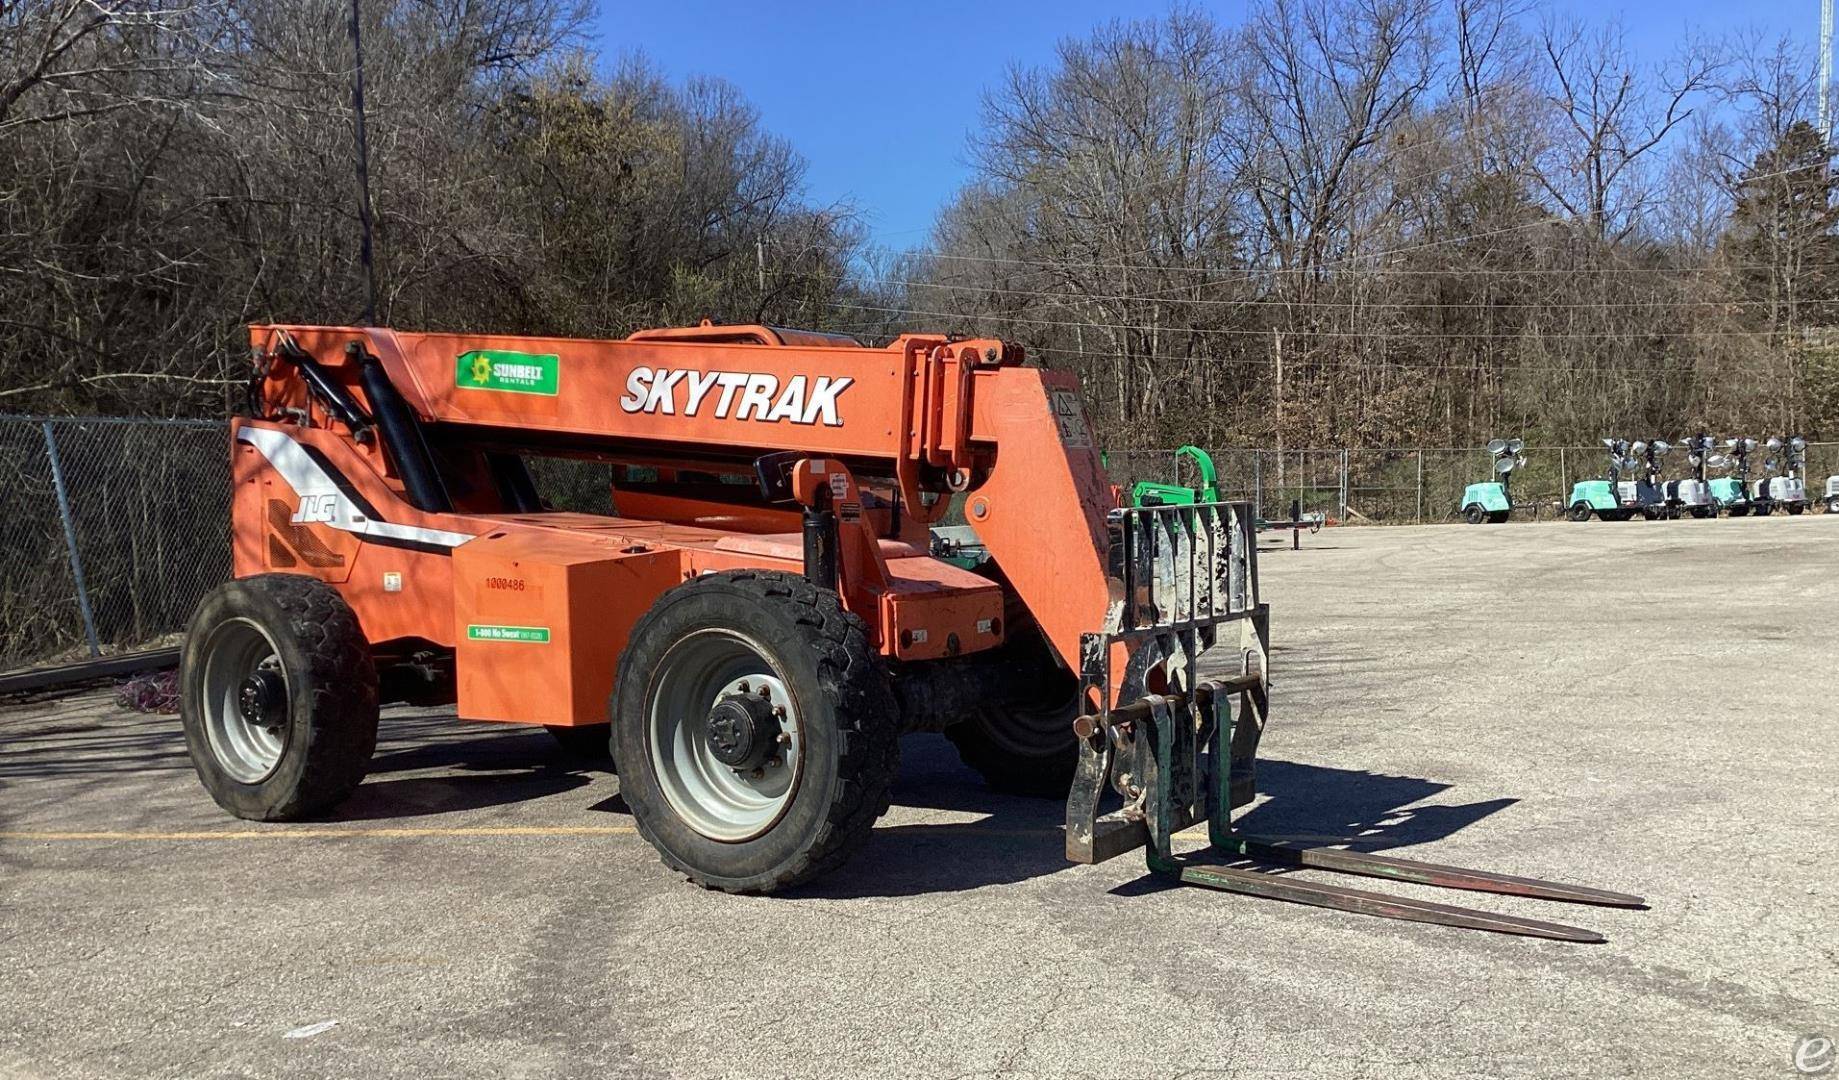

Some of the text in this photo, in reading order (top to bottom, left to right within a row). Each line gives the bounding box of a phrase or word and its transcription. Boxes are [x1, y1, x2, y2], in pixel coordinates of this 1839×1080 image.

[493, 363, 543, 380] SUNBELT
[499, 376, 535, 386] RENTALS
[619, 366, 855, 427] SKYTRAK
[291, 494, 337, 523] JLG
[486, 577, 525, 592] 1000486
